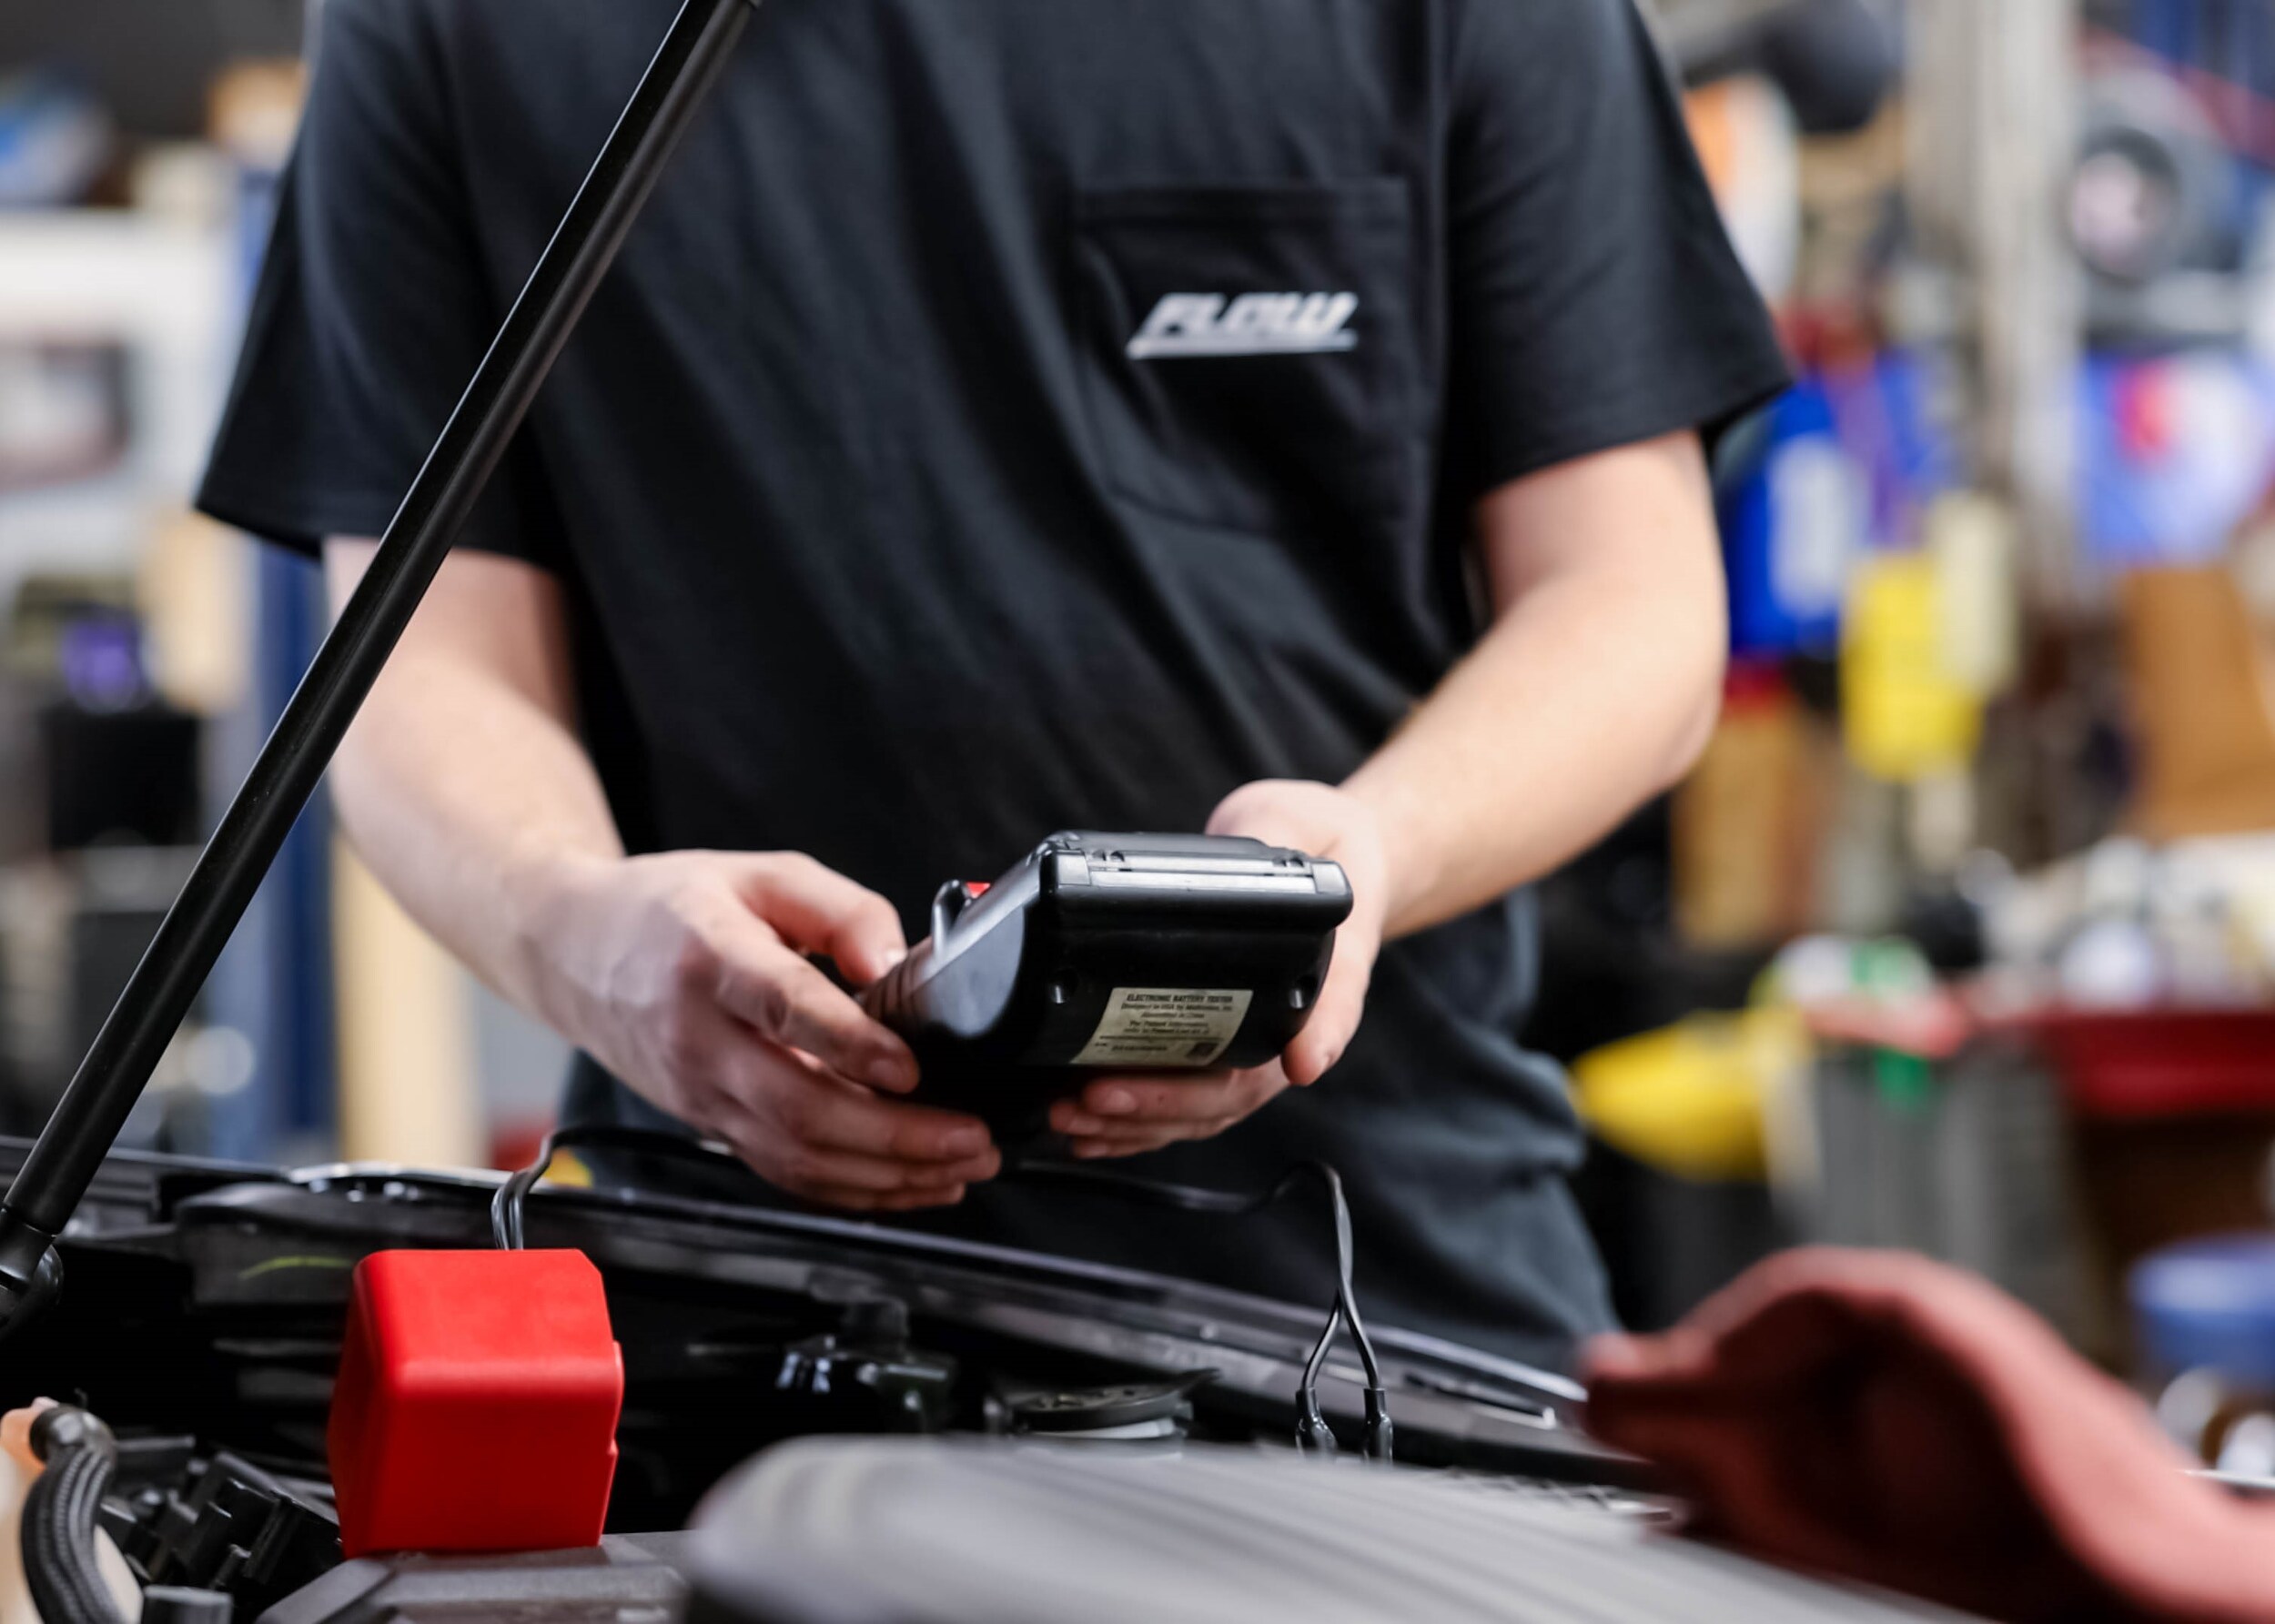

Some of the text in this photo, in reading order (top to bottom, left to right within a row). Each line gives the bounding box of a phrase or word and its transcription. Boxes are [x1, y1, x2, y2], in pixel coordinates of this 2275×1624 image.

[1129, 291, 1359, 349] FLOW
[1127, 994, 1172, 1002] ELECTRONIC
[1173, 994, 1205, 1003] BATTERY
